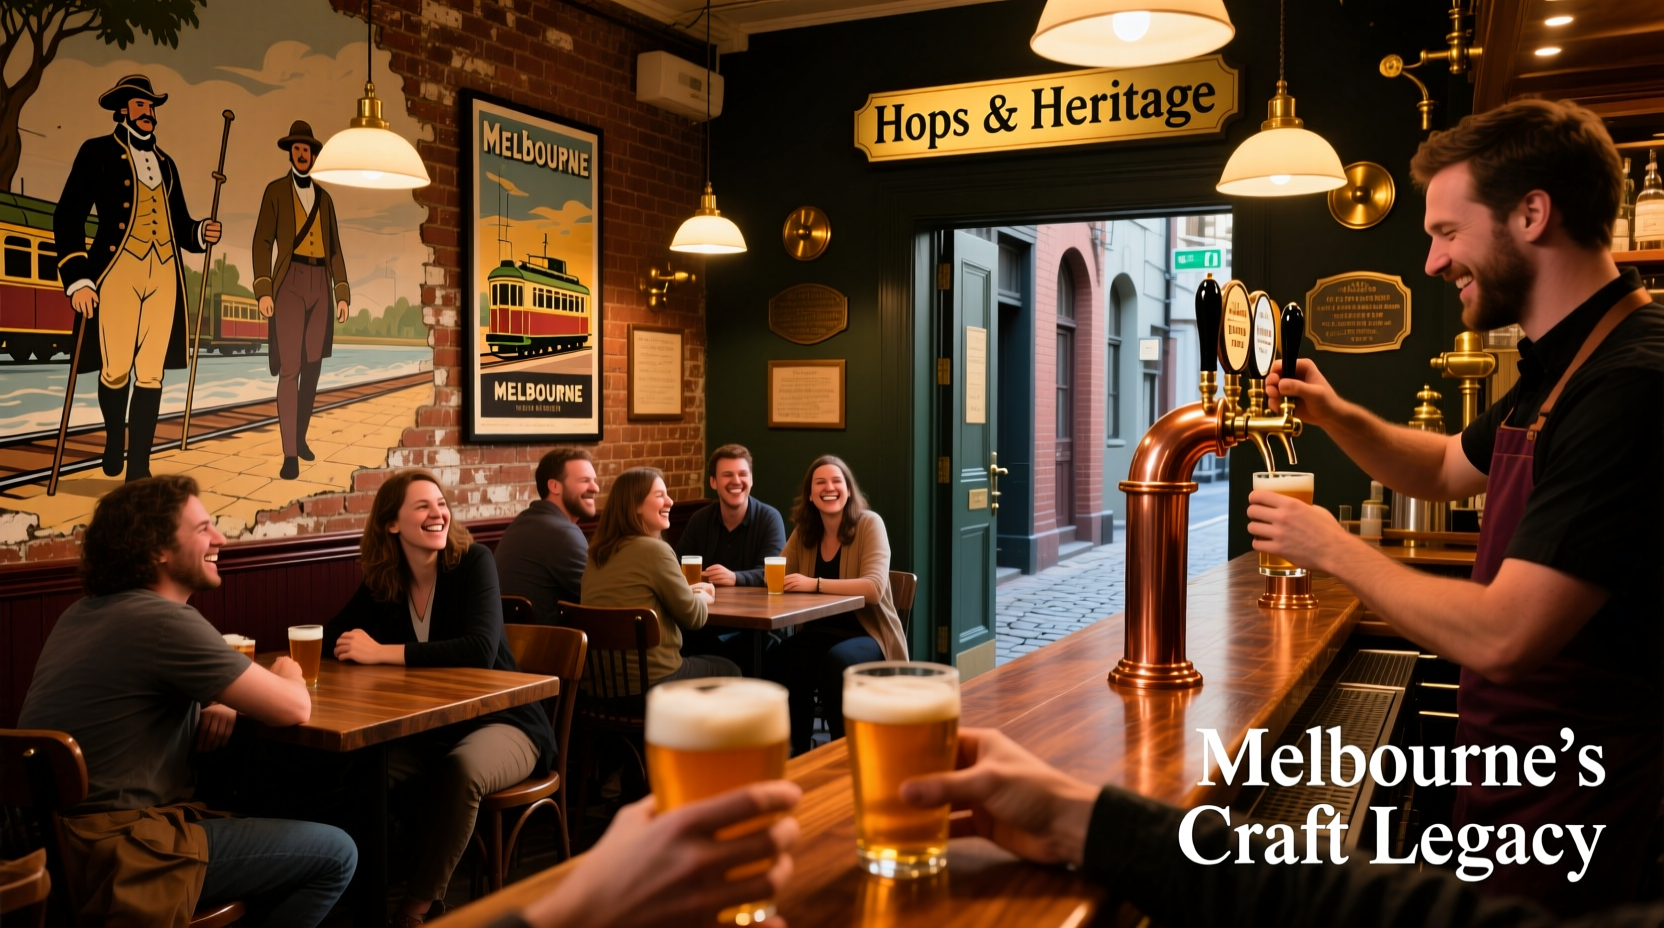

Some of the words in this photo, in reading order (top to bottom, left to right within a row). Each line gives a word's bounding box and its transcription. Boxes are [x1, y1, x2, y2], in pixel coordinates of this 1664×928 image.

[874, 103, 970, 149] Hops
[983, 94, 1018, 134] &
[1031, 79, 1217, 130] Heritage
[494, 380, 583, 403] MELBOURNE
